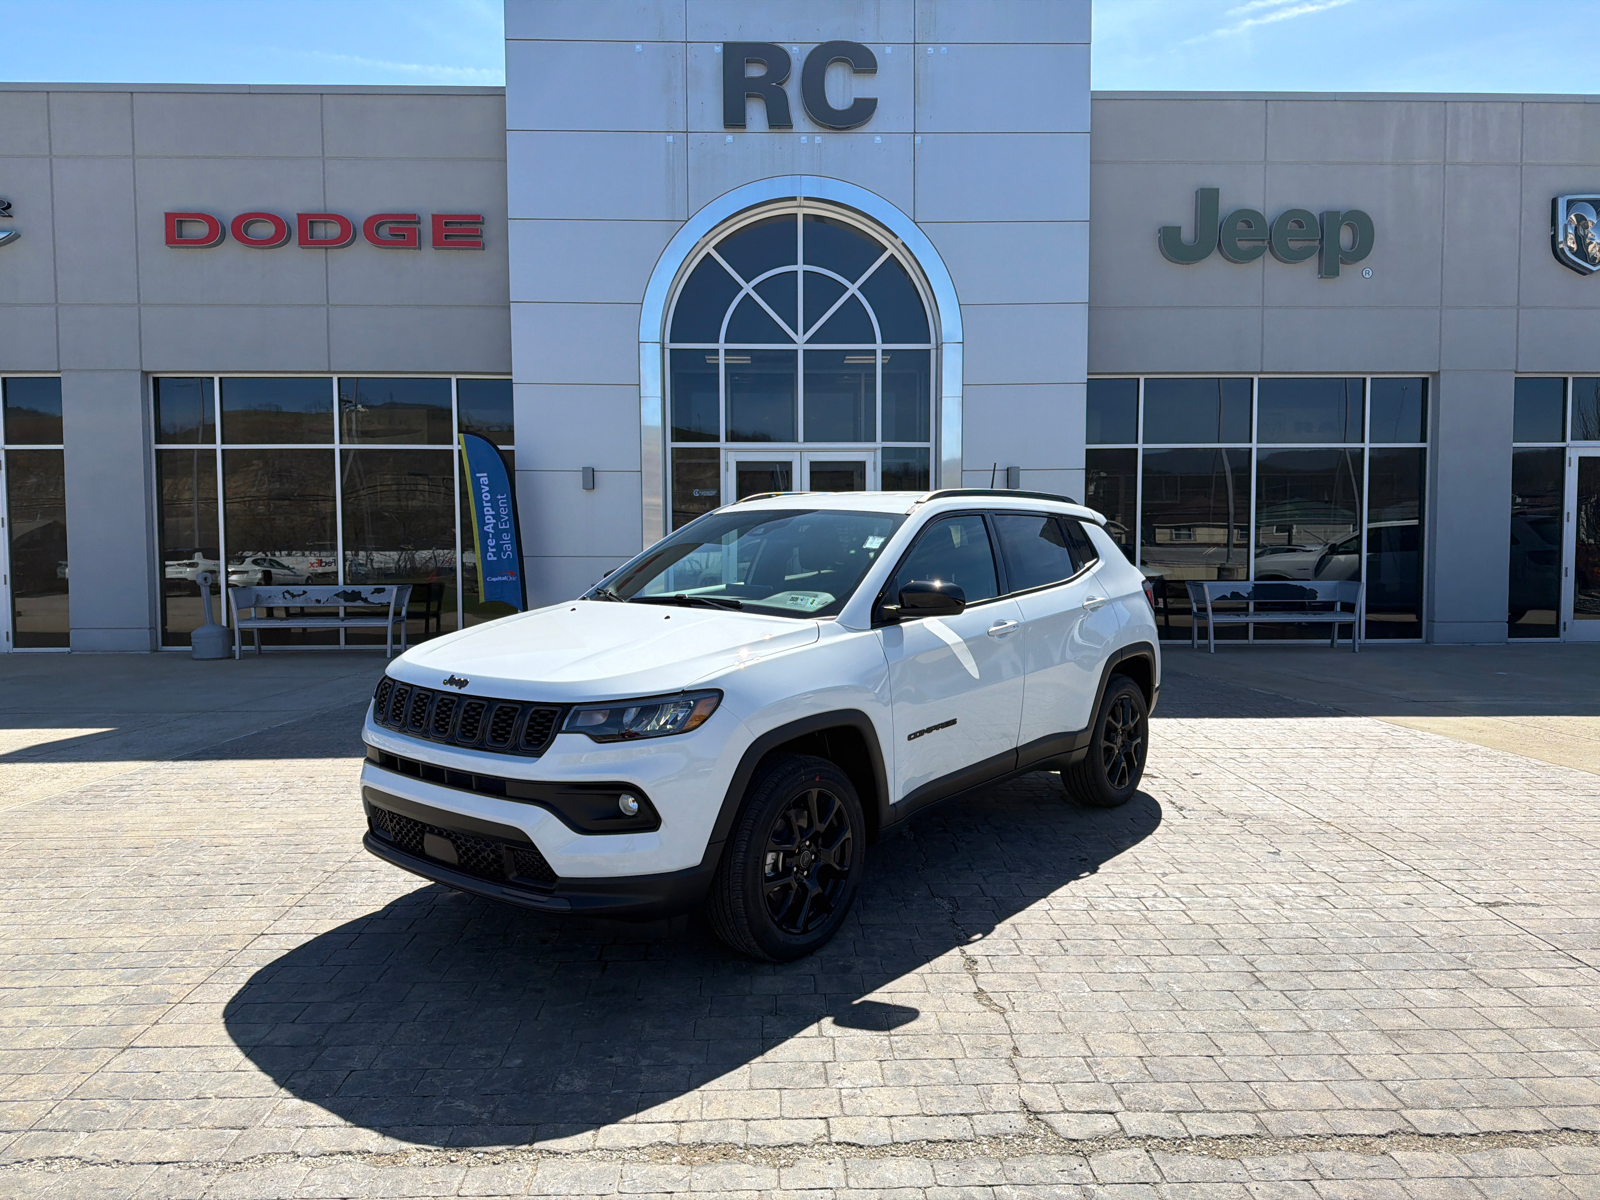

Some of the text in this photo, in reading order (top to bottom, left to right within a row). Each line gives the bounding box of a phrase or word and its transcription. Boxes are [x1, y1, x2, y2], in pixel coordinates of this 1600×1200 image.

[723, 40, 878, 131] RC
[164, 212, 485, 251] DODGE
[1158, 187, 1375, 279] Jeep
[476, 472, 497, 561] Pre-Approval
[496, 494, 512, 559] Sale Event
[442, 674, 470, 690] Jeep
